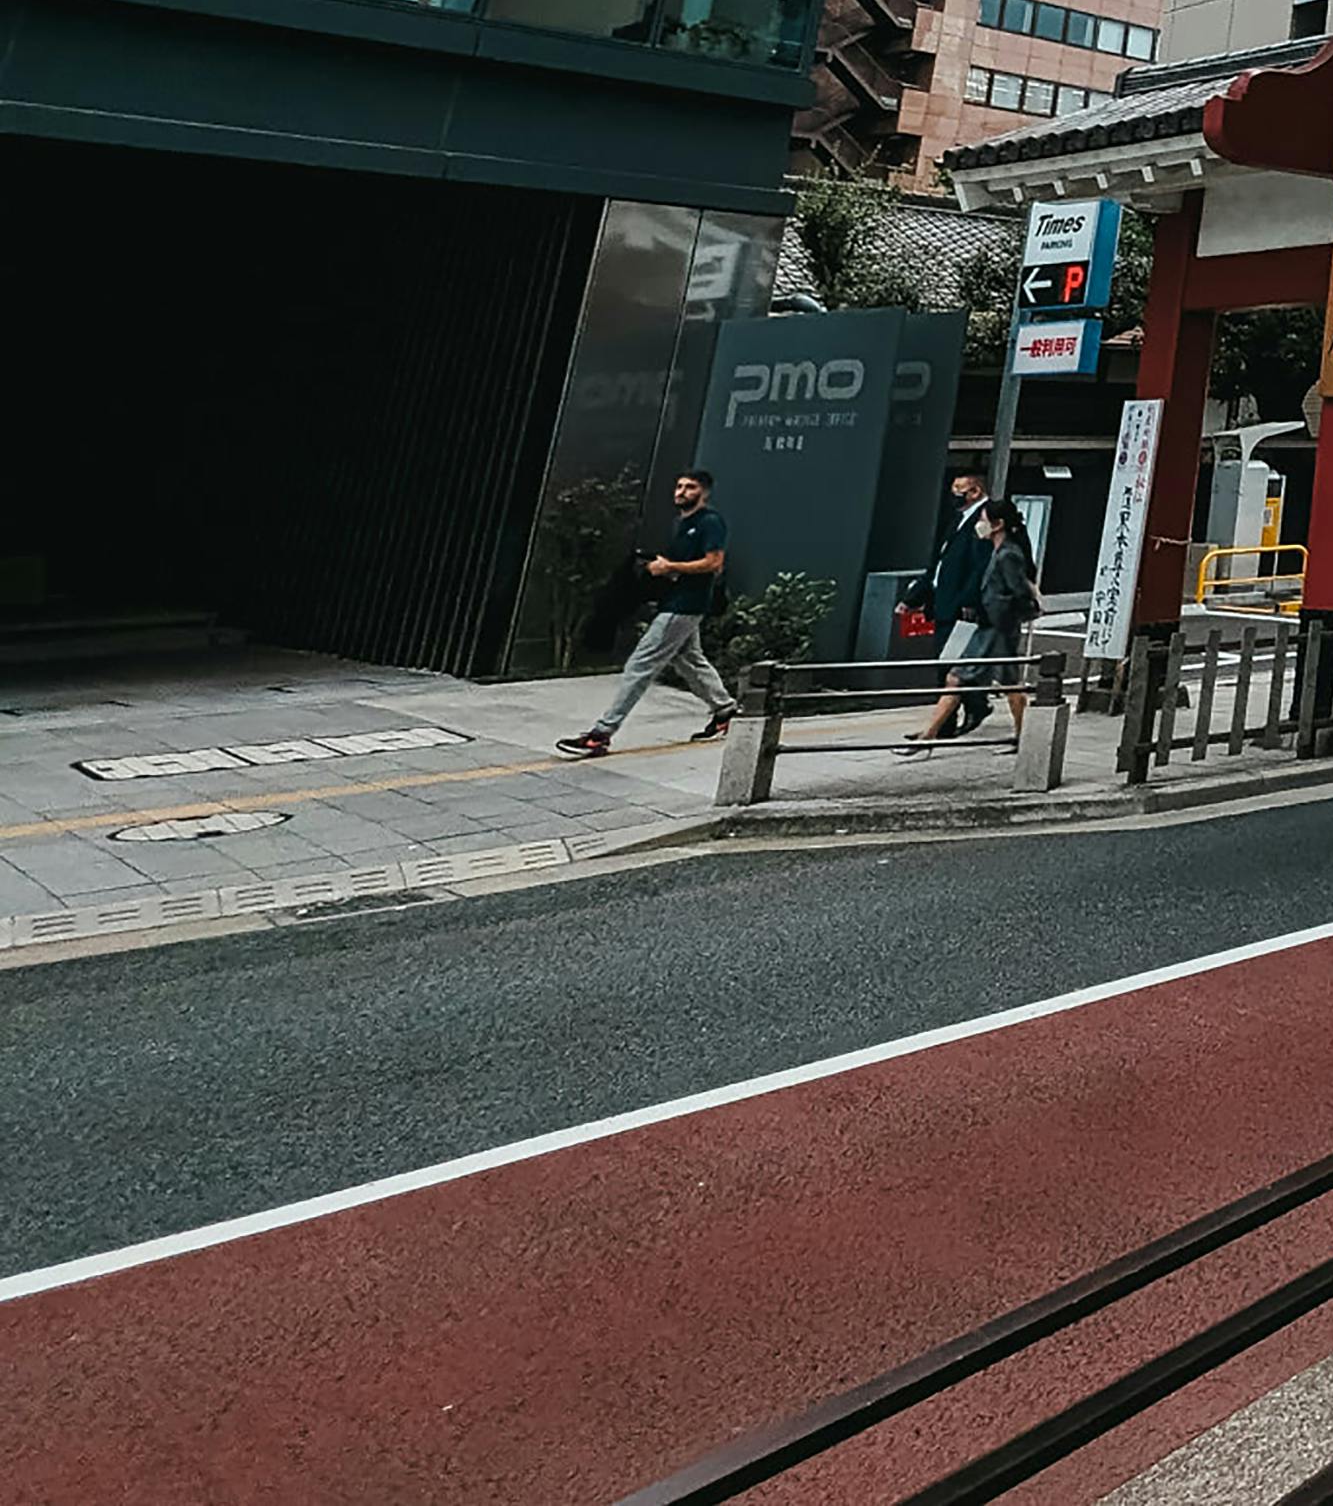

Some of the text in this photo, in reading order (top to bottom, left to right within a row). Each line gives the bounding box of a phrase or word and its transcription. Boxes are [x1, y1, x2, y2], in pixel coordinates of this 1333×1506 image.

[1034, 213, 1086, 237] Times
[1063, 264, 1085, 303] P
[724, 358, 865, 428] pmo
